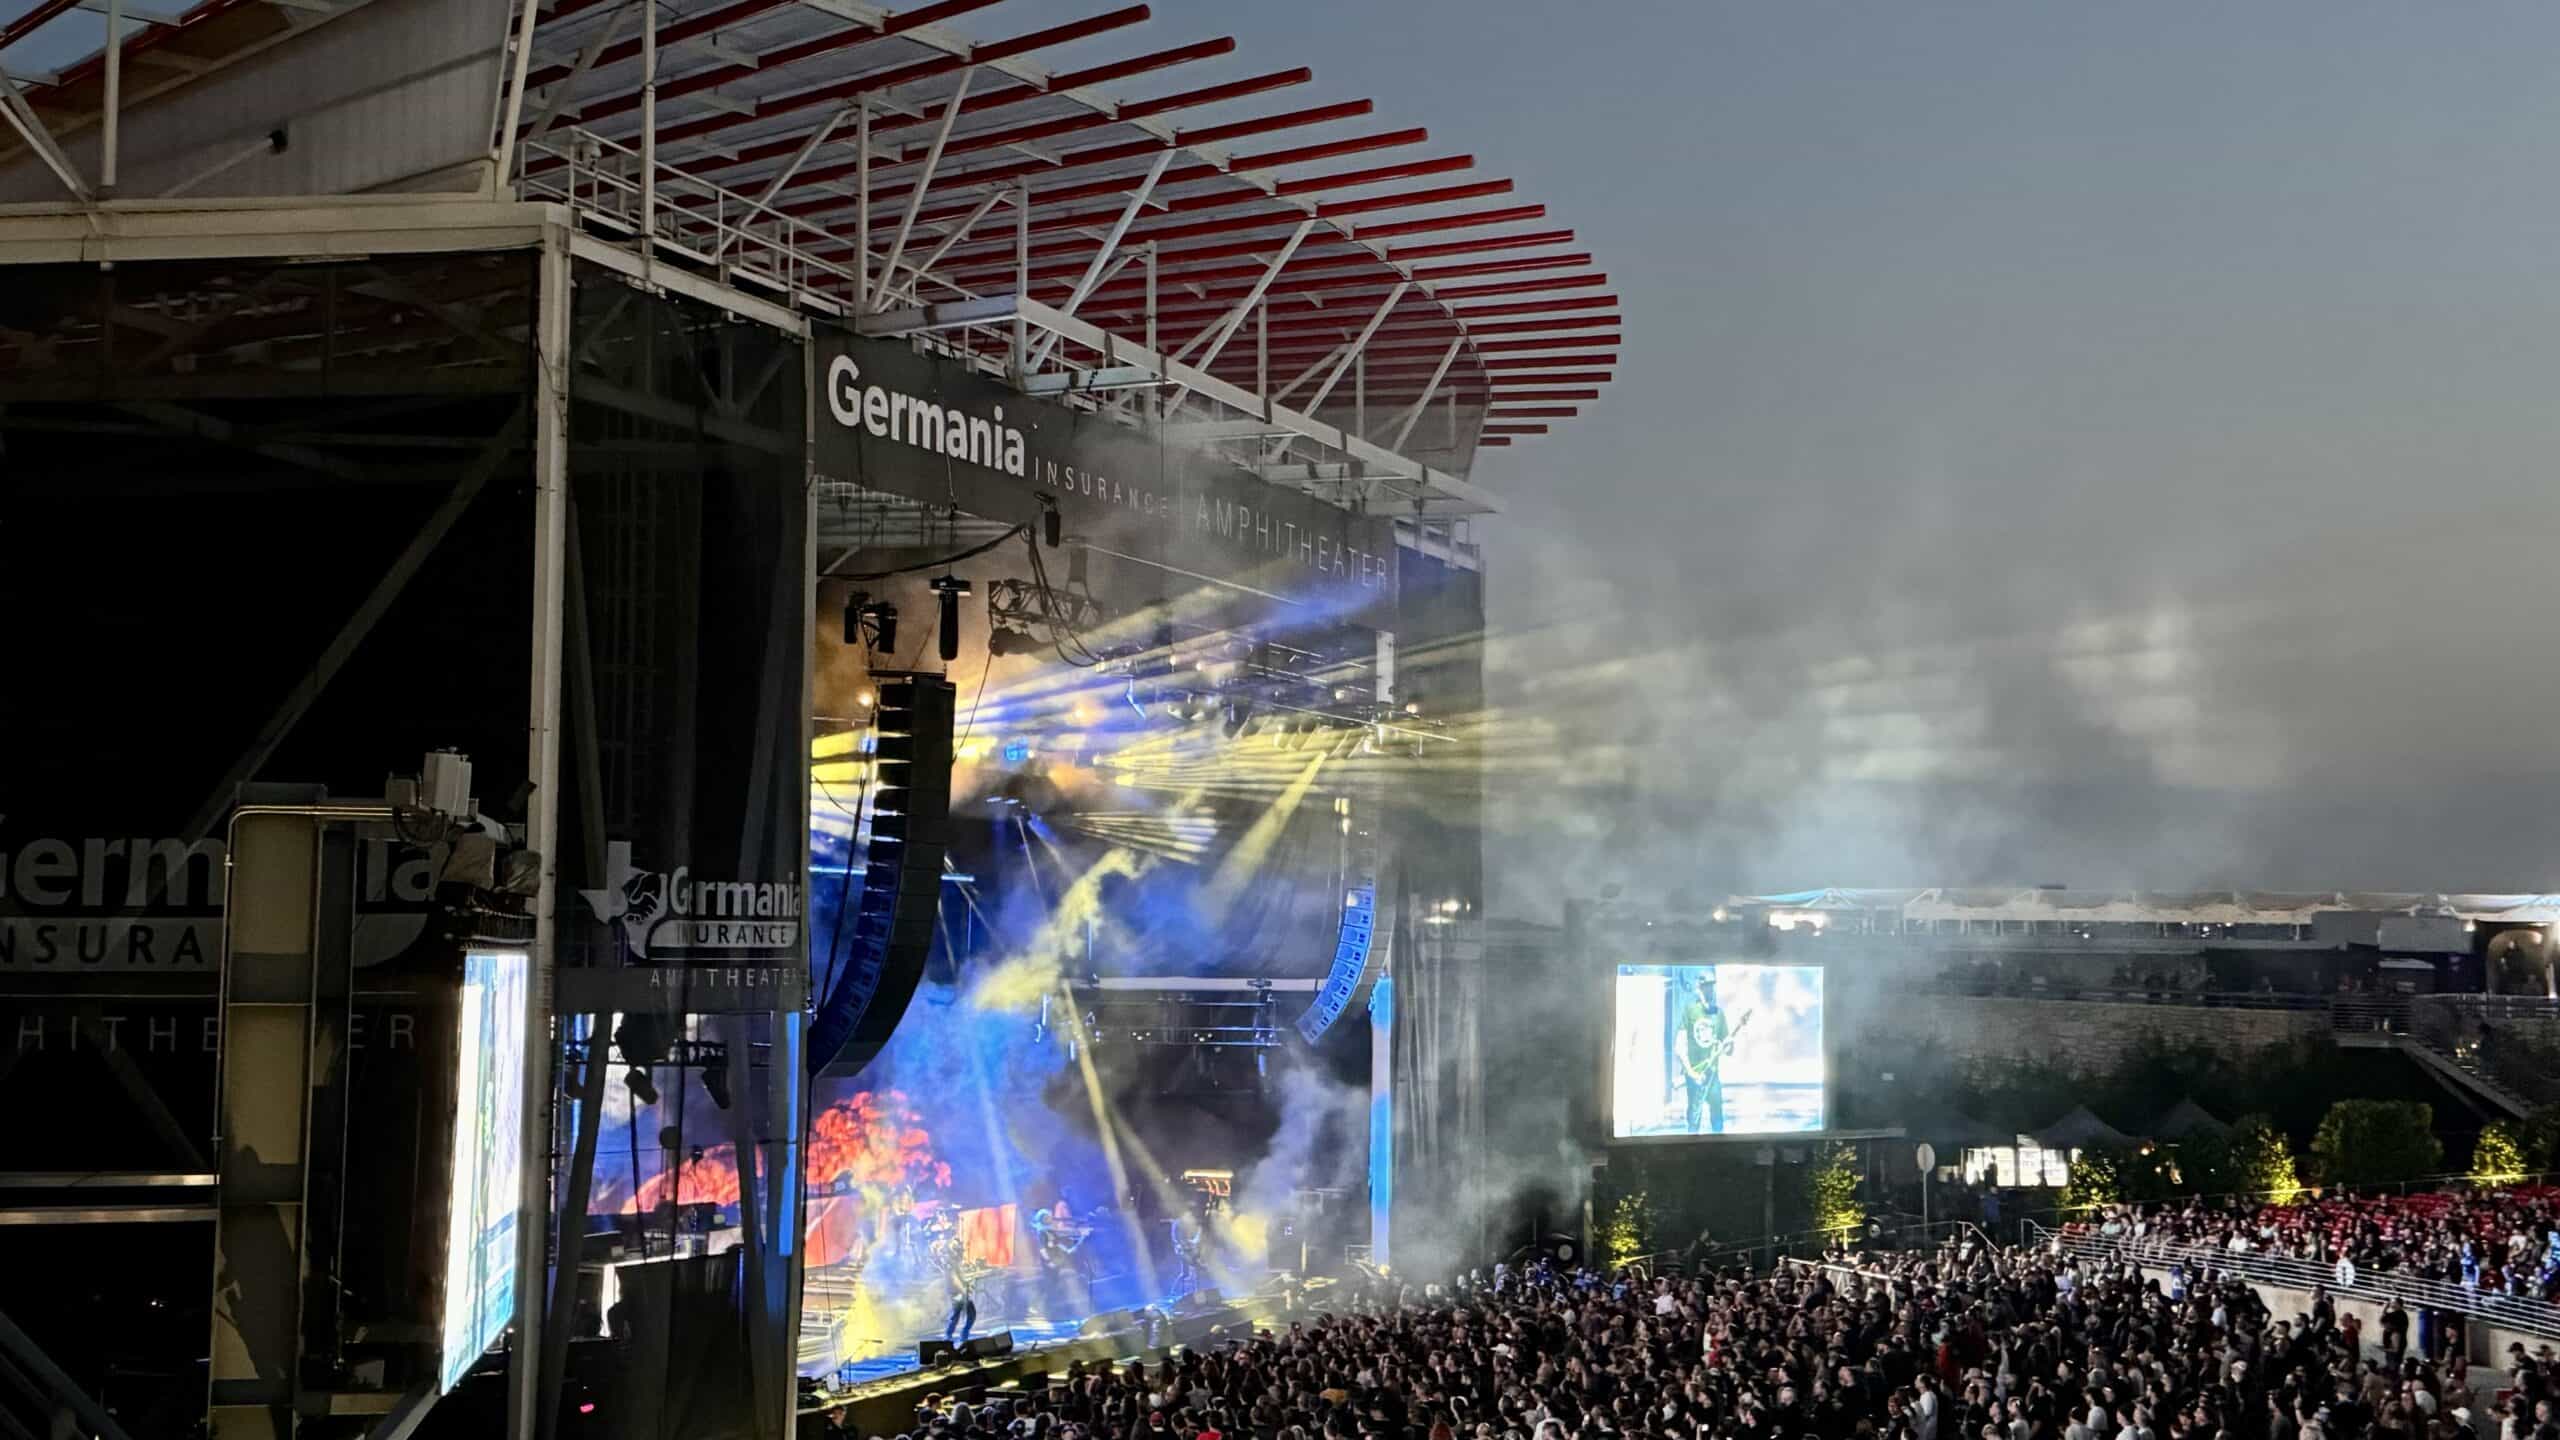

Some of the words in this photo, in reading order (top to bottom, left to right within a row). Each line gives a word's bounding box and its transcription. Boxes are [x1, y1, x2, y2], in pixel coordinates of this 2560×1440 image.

[828, 354, 1025, 478] Germania
[1034, 456, 1168, 519] INSURANCE
[1195, 493, 1388, 589] AMPHITHEATER
[670, 865, 801, 917] Grmania
